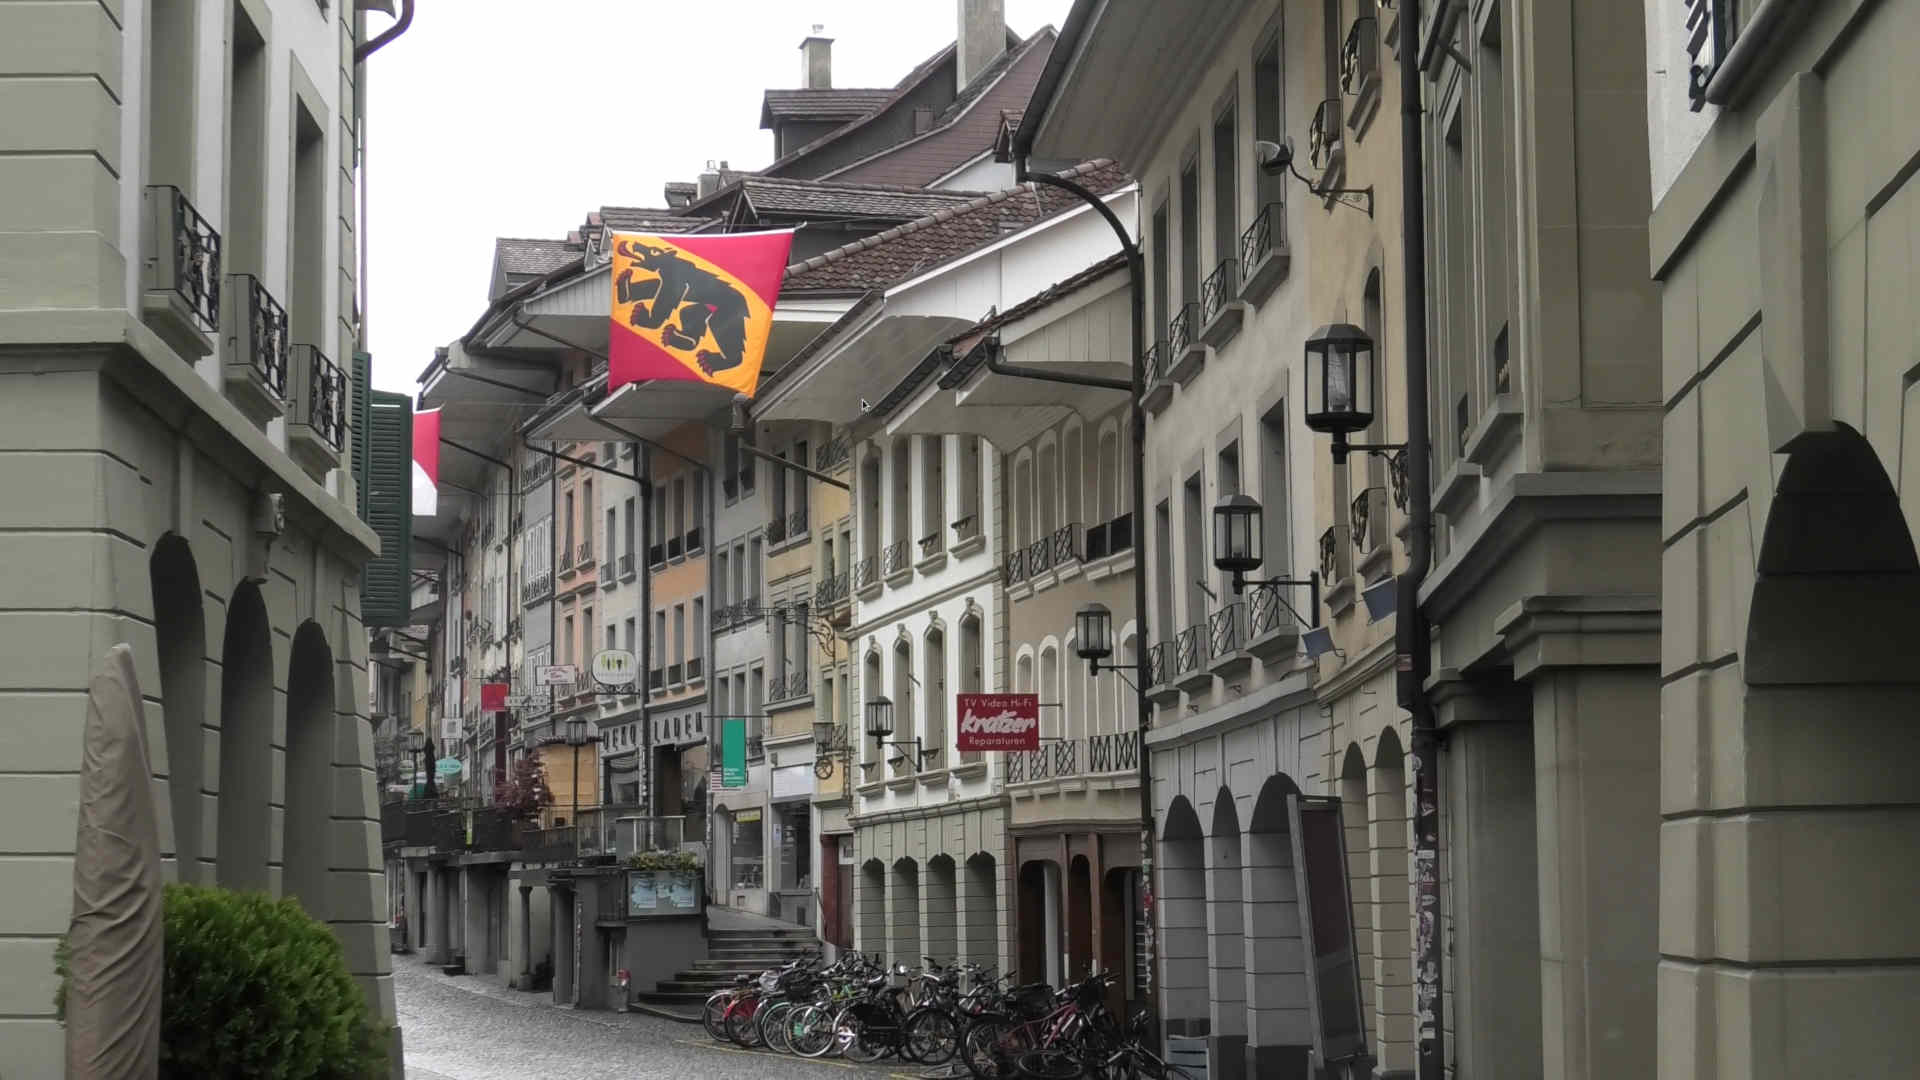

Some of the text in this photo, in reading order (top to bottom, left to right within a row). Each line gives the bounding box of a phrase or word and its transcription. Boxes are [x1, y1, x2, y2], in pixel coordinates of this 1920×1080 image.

[964, 698, 977, 706] TV
[981, 698, 1008, 707] Video
[654, 712, 703, 743] LADEN
[969, 736, 1025, 746] Reparaturen
